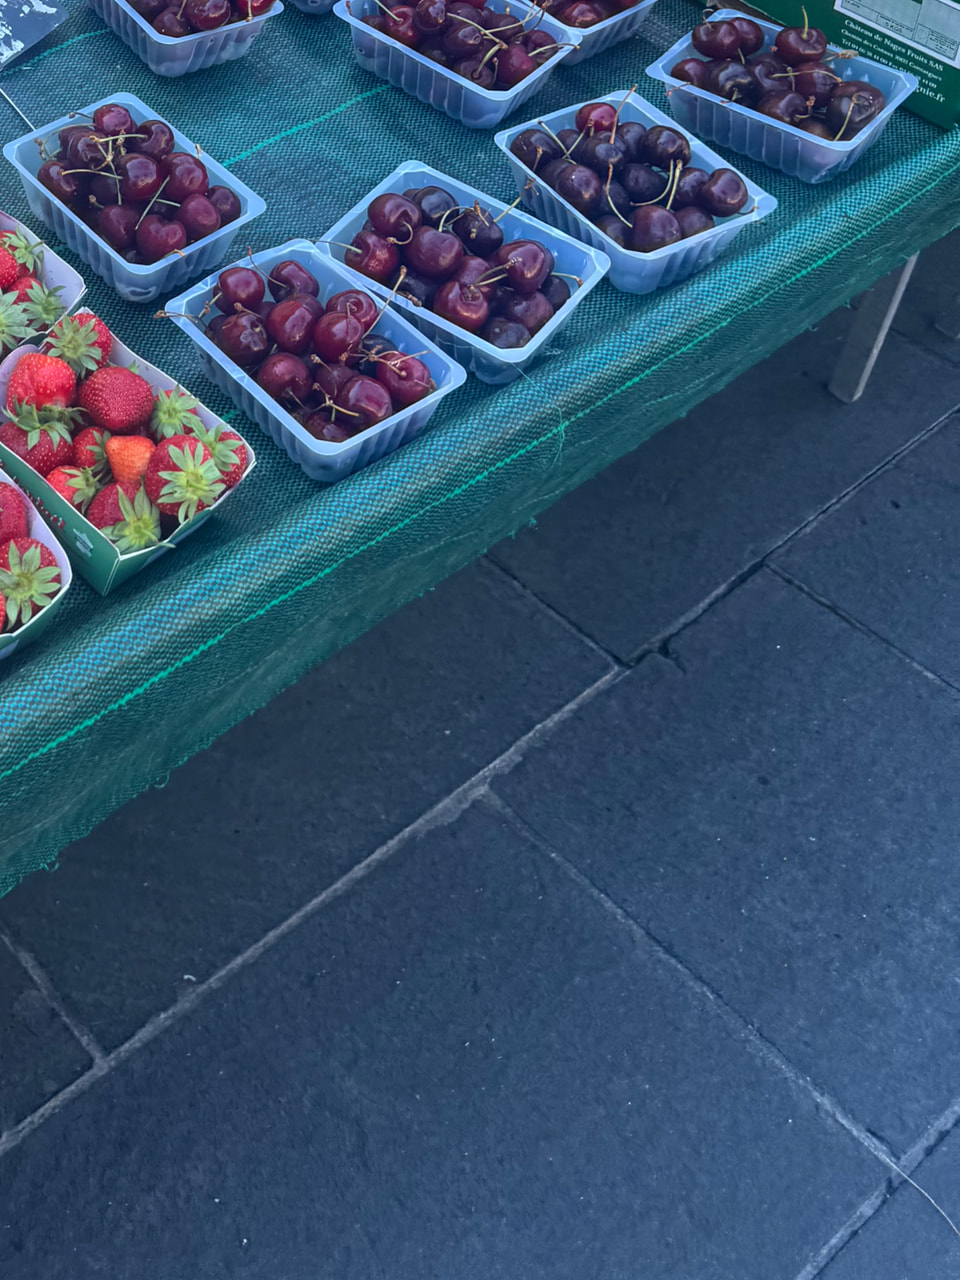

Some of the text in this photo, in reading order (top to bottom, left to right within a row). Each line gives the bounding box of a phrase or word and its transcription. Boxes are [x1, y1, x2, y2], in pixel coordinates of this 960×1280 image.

[843, 19, 944, 71] Château de Nages Fruits SAS
